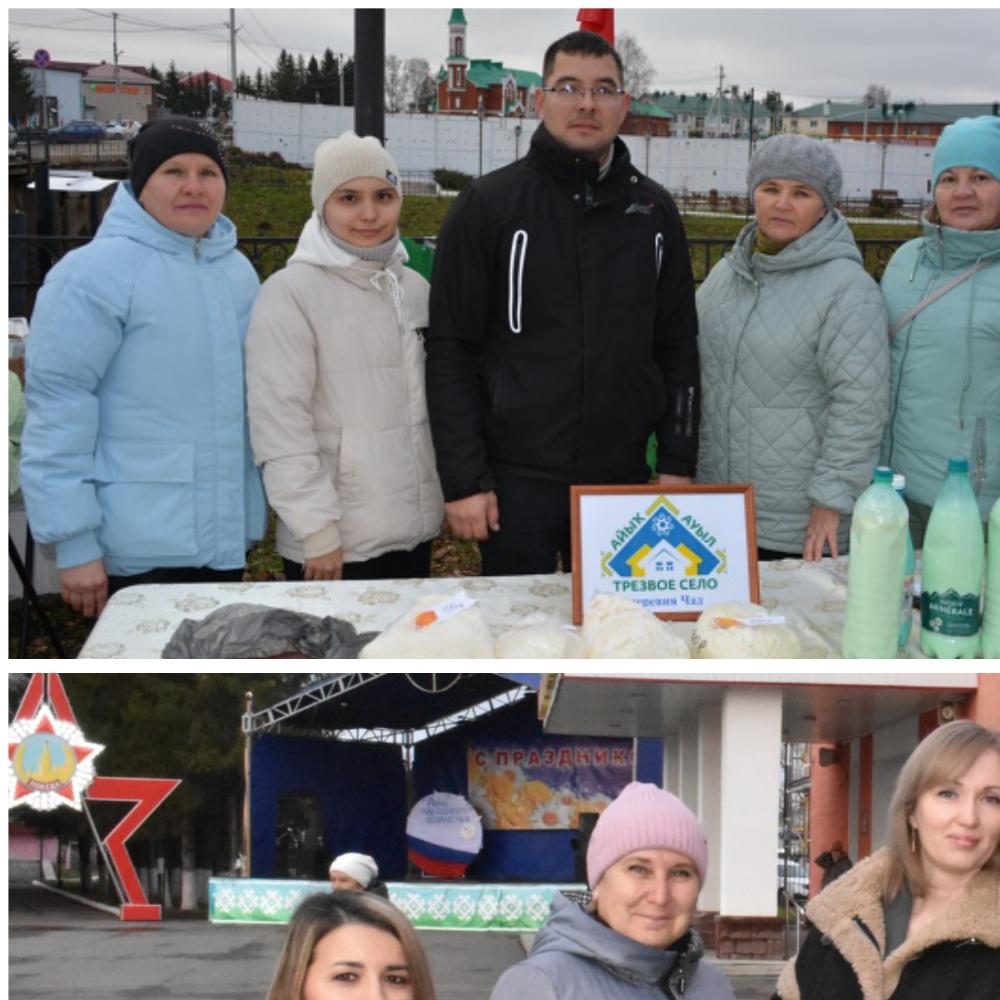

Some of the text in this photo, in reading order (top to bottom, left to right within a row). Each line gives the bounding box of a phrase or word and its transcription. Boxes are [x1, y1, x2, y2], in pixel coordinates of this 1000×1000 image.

[681, 514, 717, 548] АУЫЛ
[613, 577, 718, 592] ТРЕЗВОЕ СЕЛО
[475, 750, 486, 766] С
